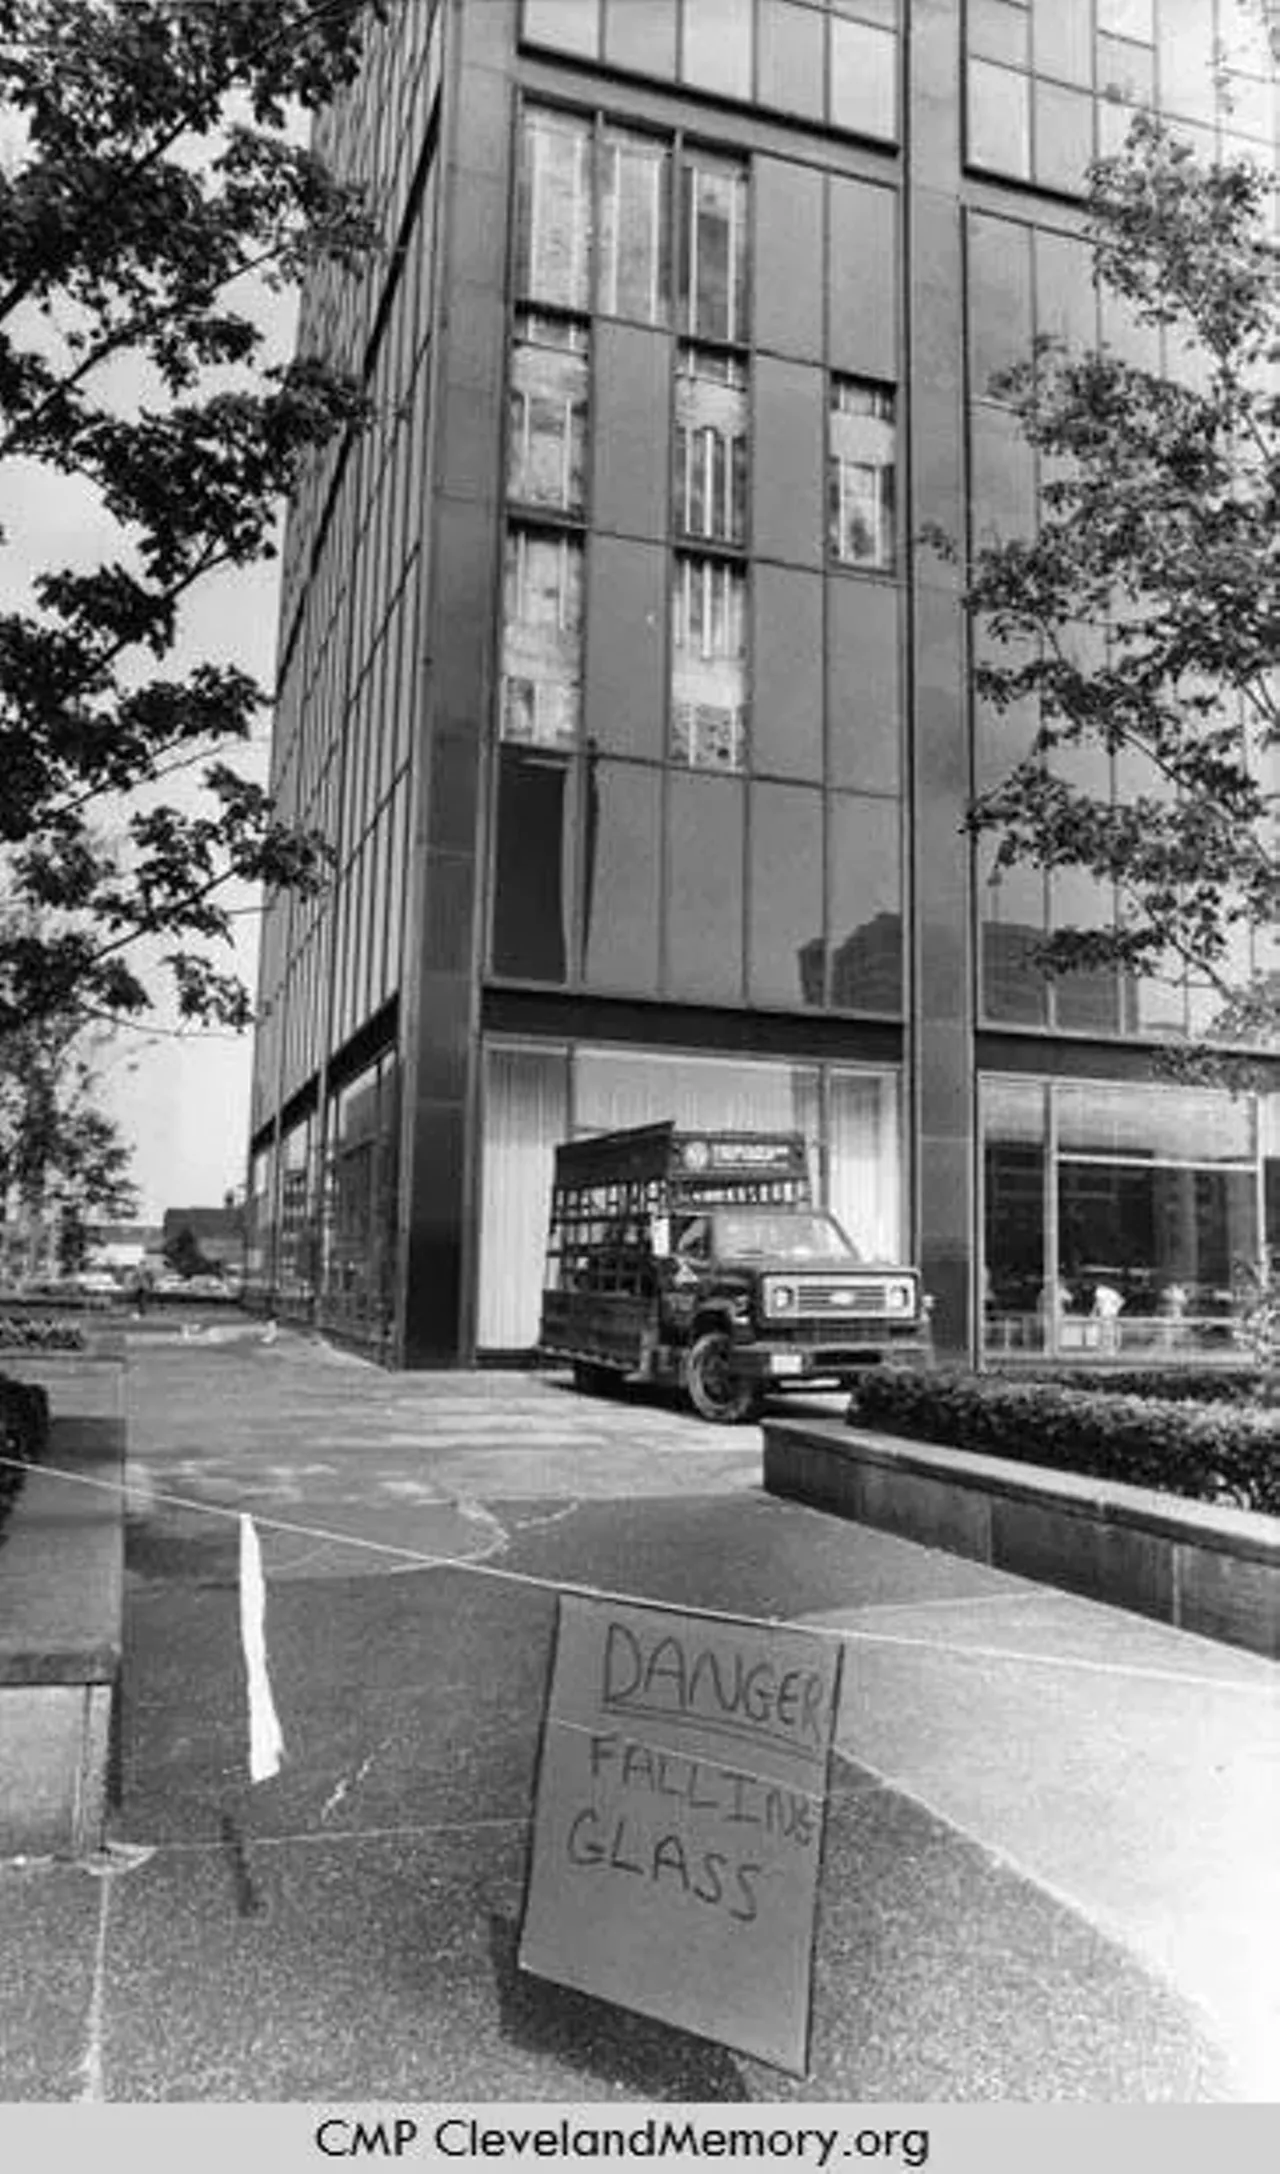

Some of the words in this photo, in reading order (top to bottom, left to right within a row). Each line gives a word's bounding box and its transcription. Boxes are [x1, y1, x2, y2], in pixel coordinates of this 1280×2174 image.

[604, 1622, 824, 1745] DANGER
[591, 1733, 820, 1847] FALLING
[568, 1807, 763, 1921] GLASS
